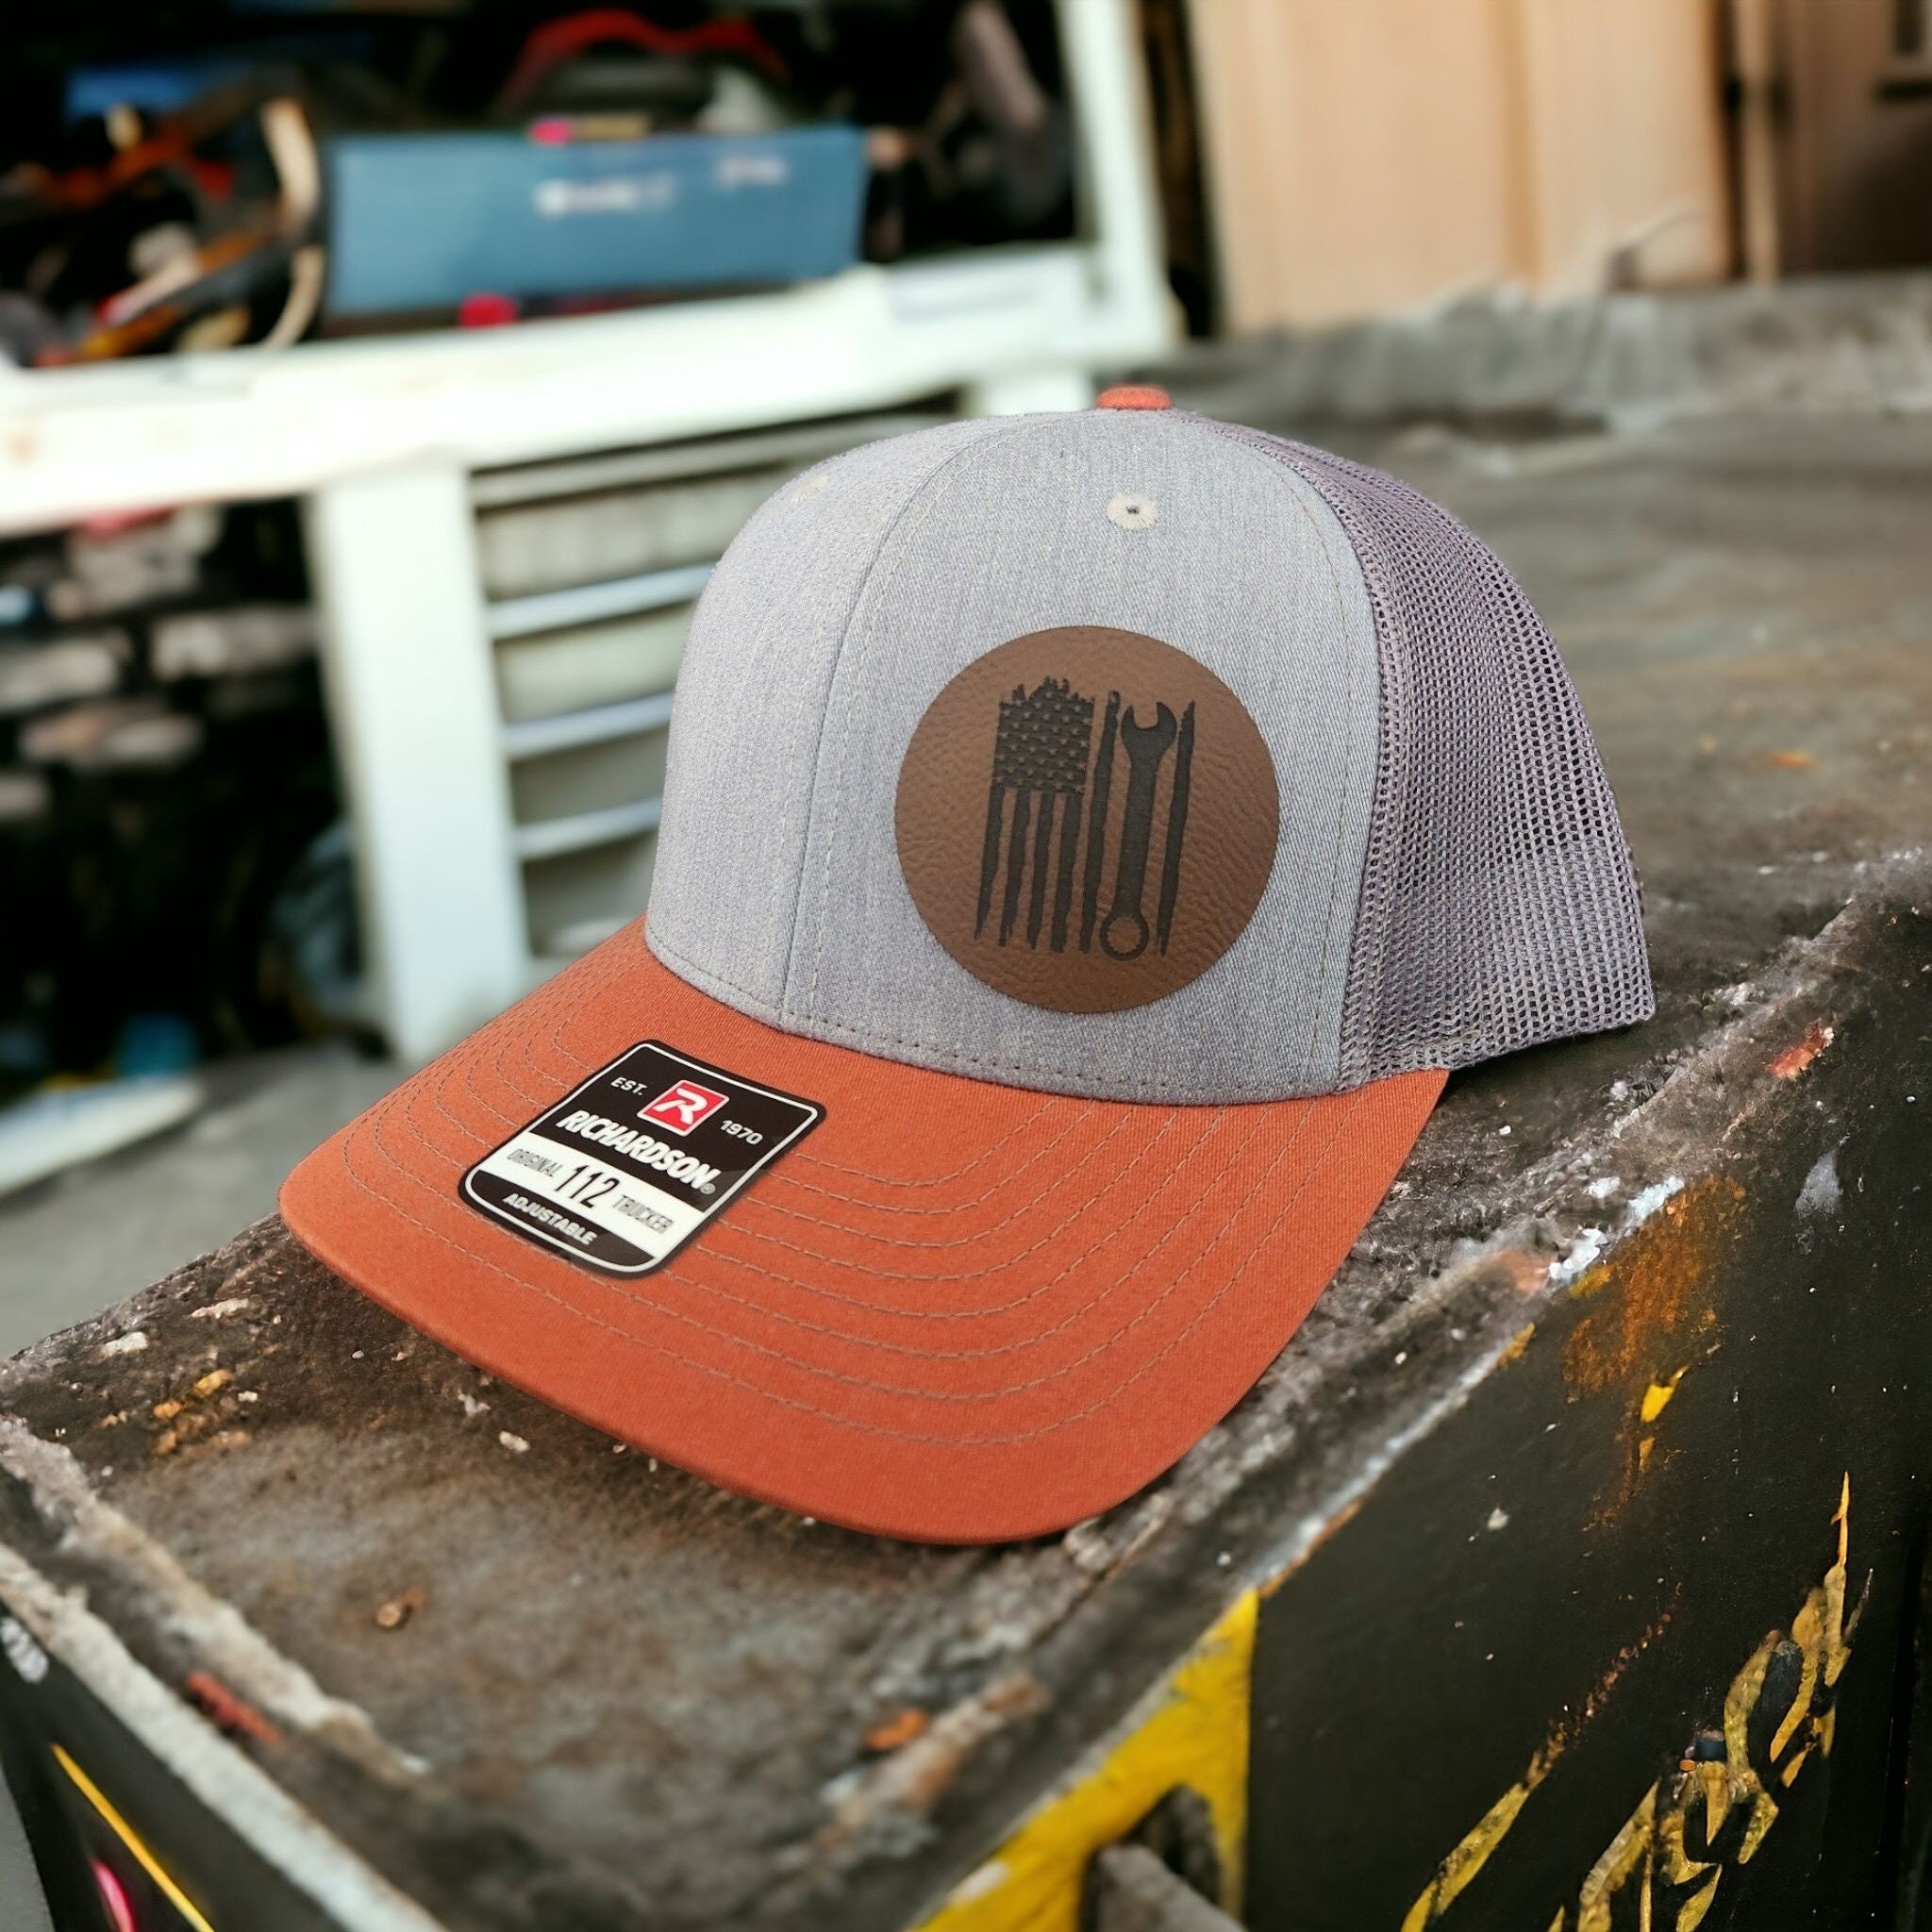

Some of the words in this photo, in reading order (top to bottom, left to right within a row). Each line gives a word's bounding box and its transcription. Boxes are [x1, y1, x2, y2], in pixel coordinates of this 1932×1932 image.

[609, 1075, 648, 1097] EST.
[720, 1118, 764, 1145] 1970
[553, 1163, 622, 1209] 112
[502, 1192, 599, 1246] ADJUSTABLE
